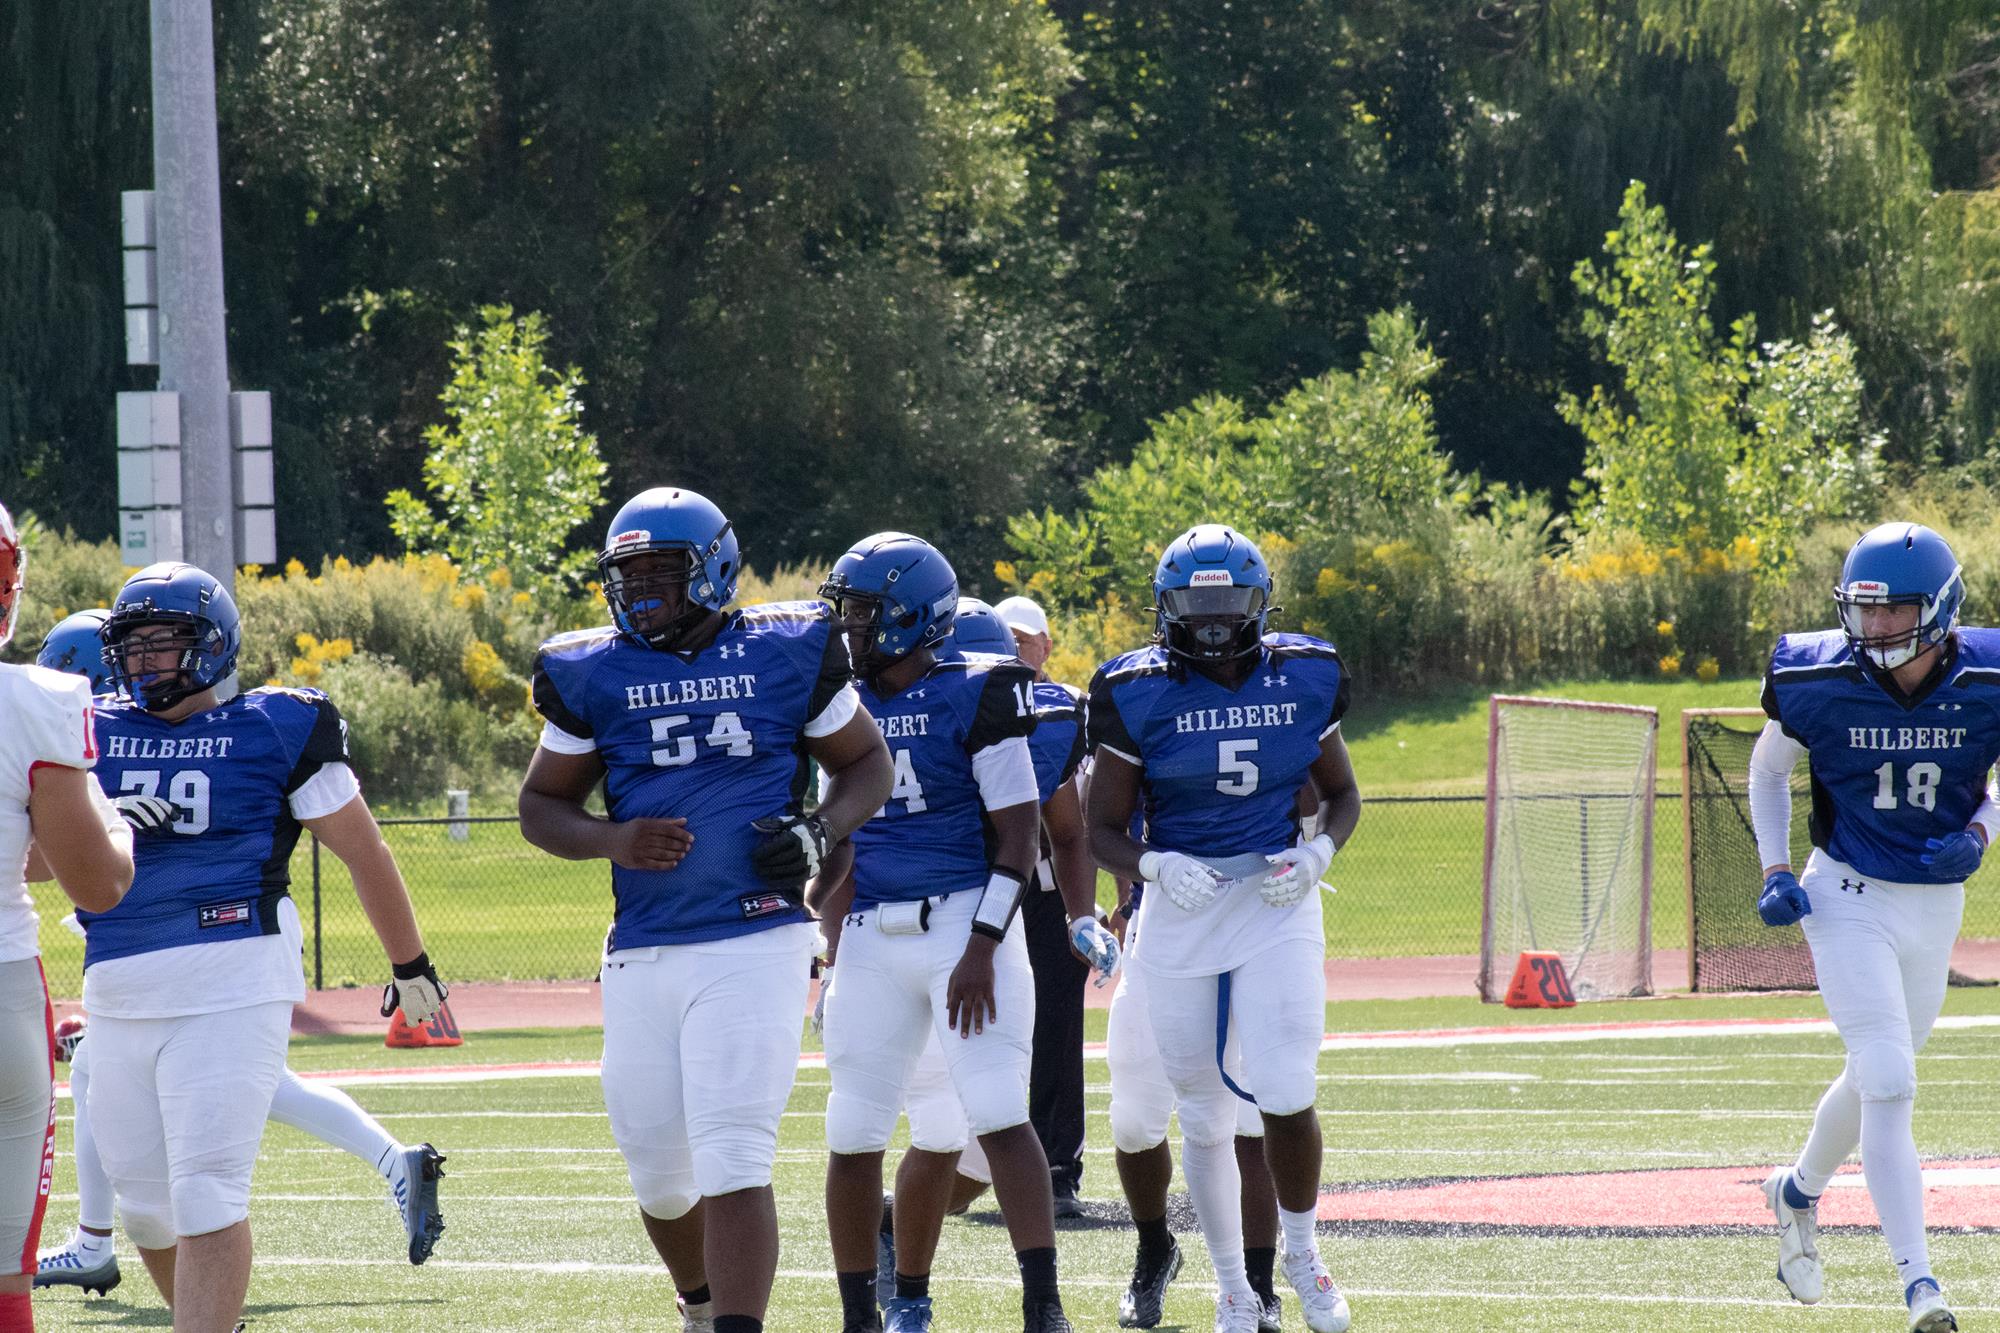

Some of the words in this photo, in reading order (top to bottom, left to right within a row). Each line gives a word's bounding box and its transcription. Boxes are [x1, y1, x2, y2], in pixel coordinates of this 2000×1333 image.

[1194, 573, 1228, 582] Riddell
[1857, 582, 1879, 591] Riddell
[625, 674, 756, 710] HILBERT
[1012, 680, 1035, 717] 14
[874, 713, 929, 739] BERT
[1176, 703, 1297, 733] HILBERT
[106, 735, 233, 759] HILBERT
[650, 711, 753, 767] 54
[1848, 727, 1967, 750] HILBERT
[873, 748, 928, 818] 4
[1216, 738, 1259, 797] 5
[119, 769, 211, 835] 79
[1873, 761, 1942, 812] 18
[1530, 957, 1576, 1003] 20
[40, 1135, 54, 1195] RED
